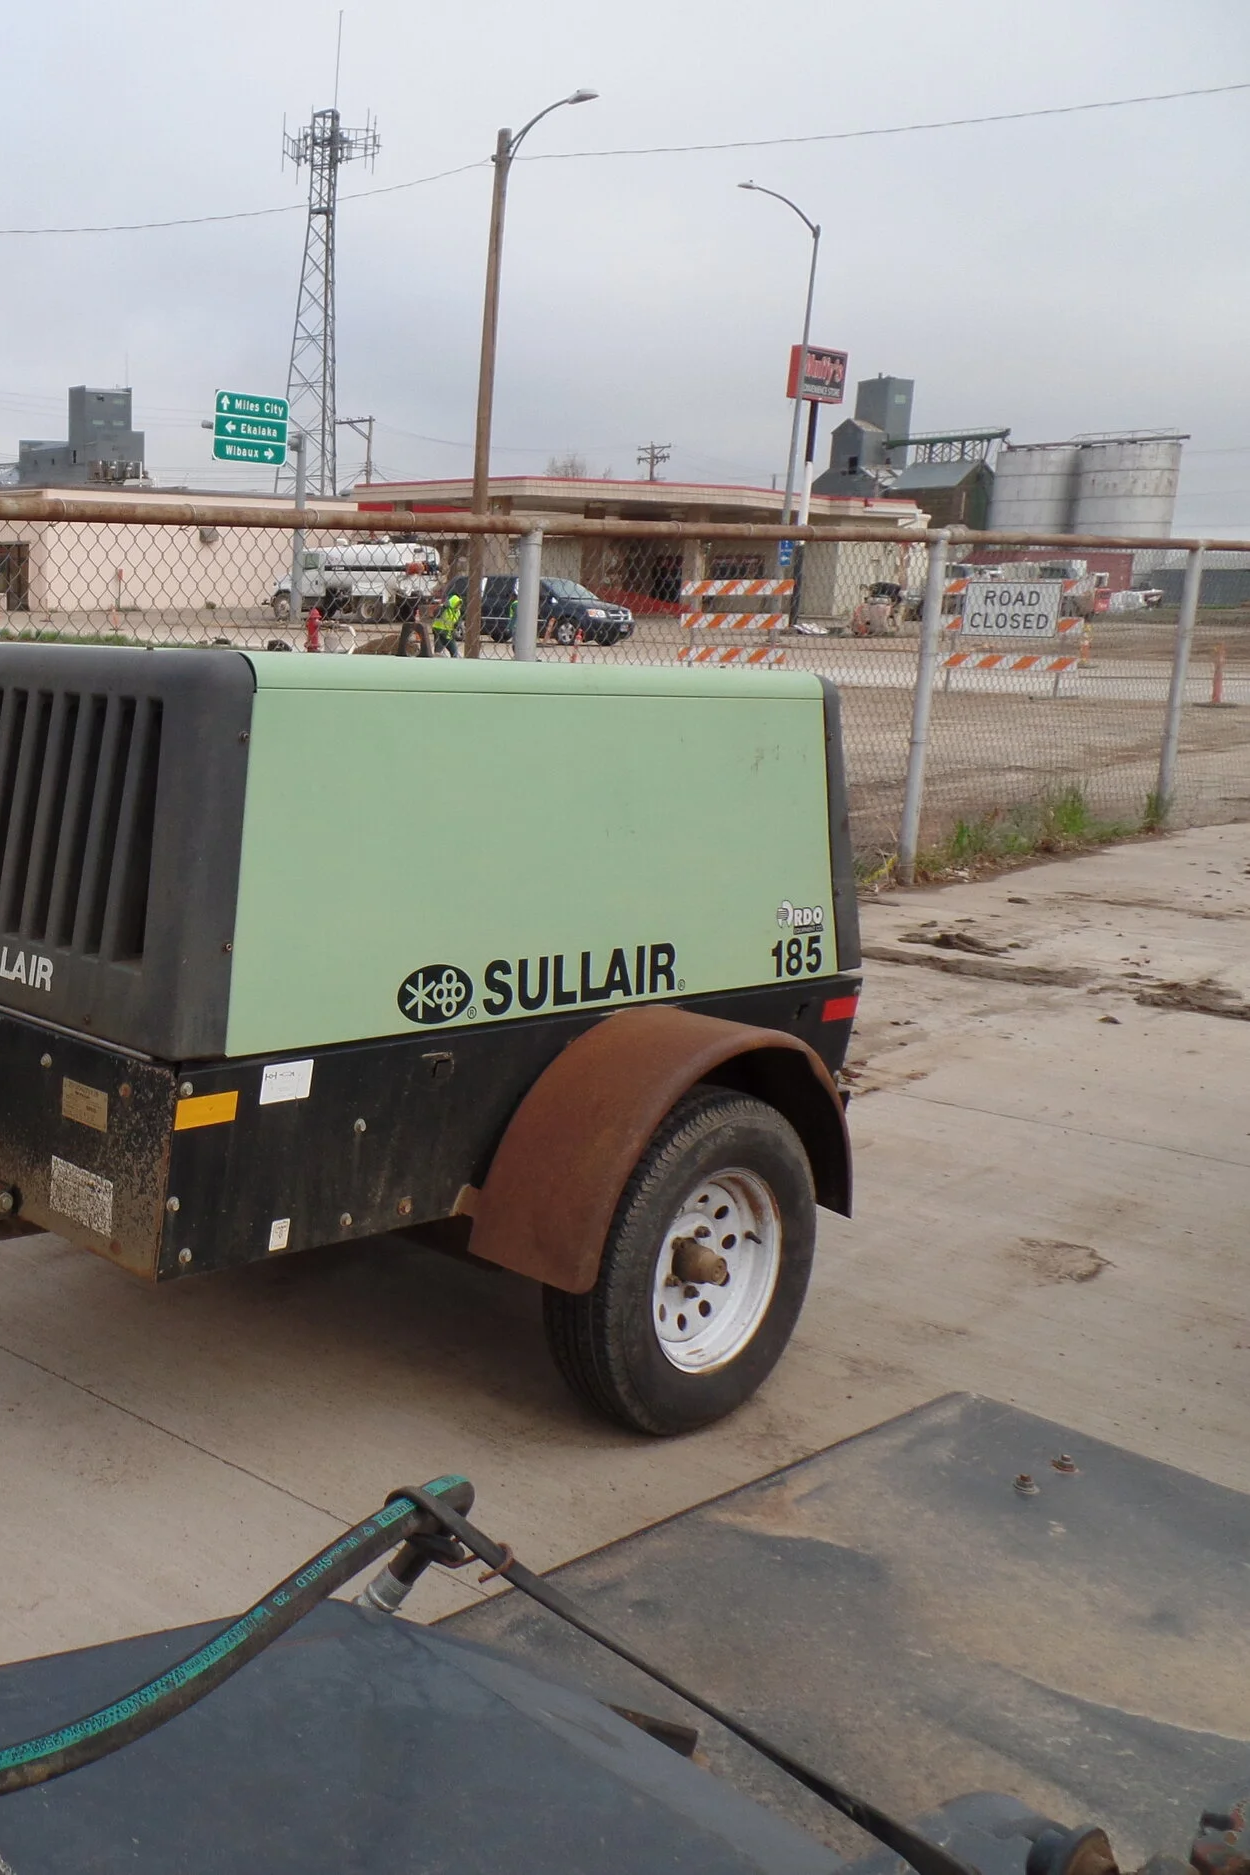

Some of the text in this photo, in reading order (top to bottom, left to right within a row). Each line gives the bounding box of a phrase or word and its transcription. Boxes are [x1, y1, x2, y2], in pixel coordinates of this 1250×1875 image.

[234, 399, 284, 417] Miles City
[240, 423, 278, 437] Ekalaka
[225, 444, 259, 458] Wibaux
[984, 590, 1041, 606] ROAD
[970, 612, 1049, 630] CLOSED
[793, 906, 823, 927] RDO
[771, 935, 822, 978] 185
[482, 942, 676, 1016] SULLAIR
